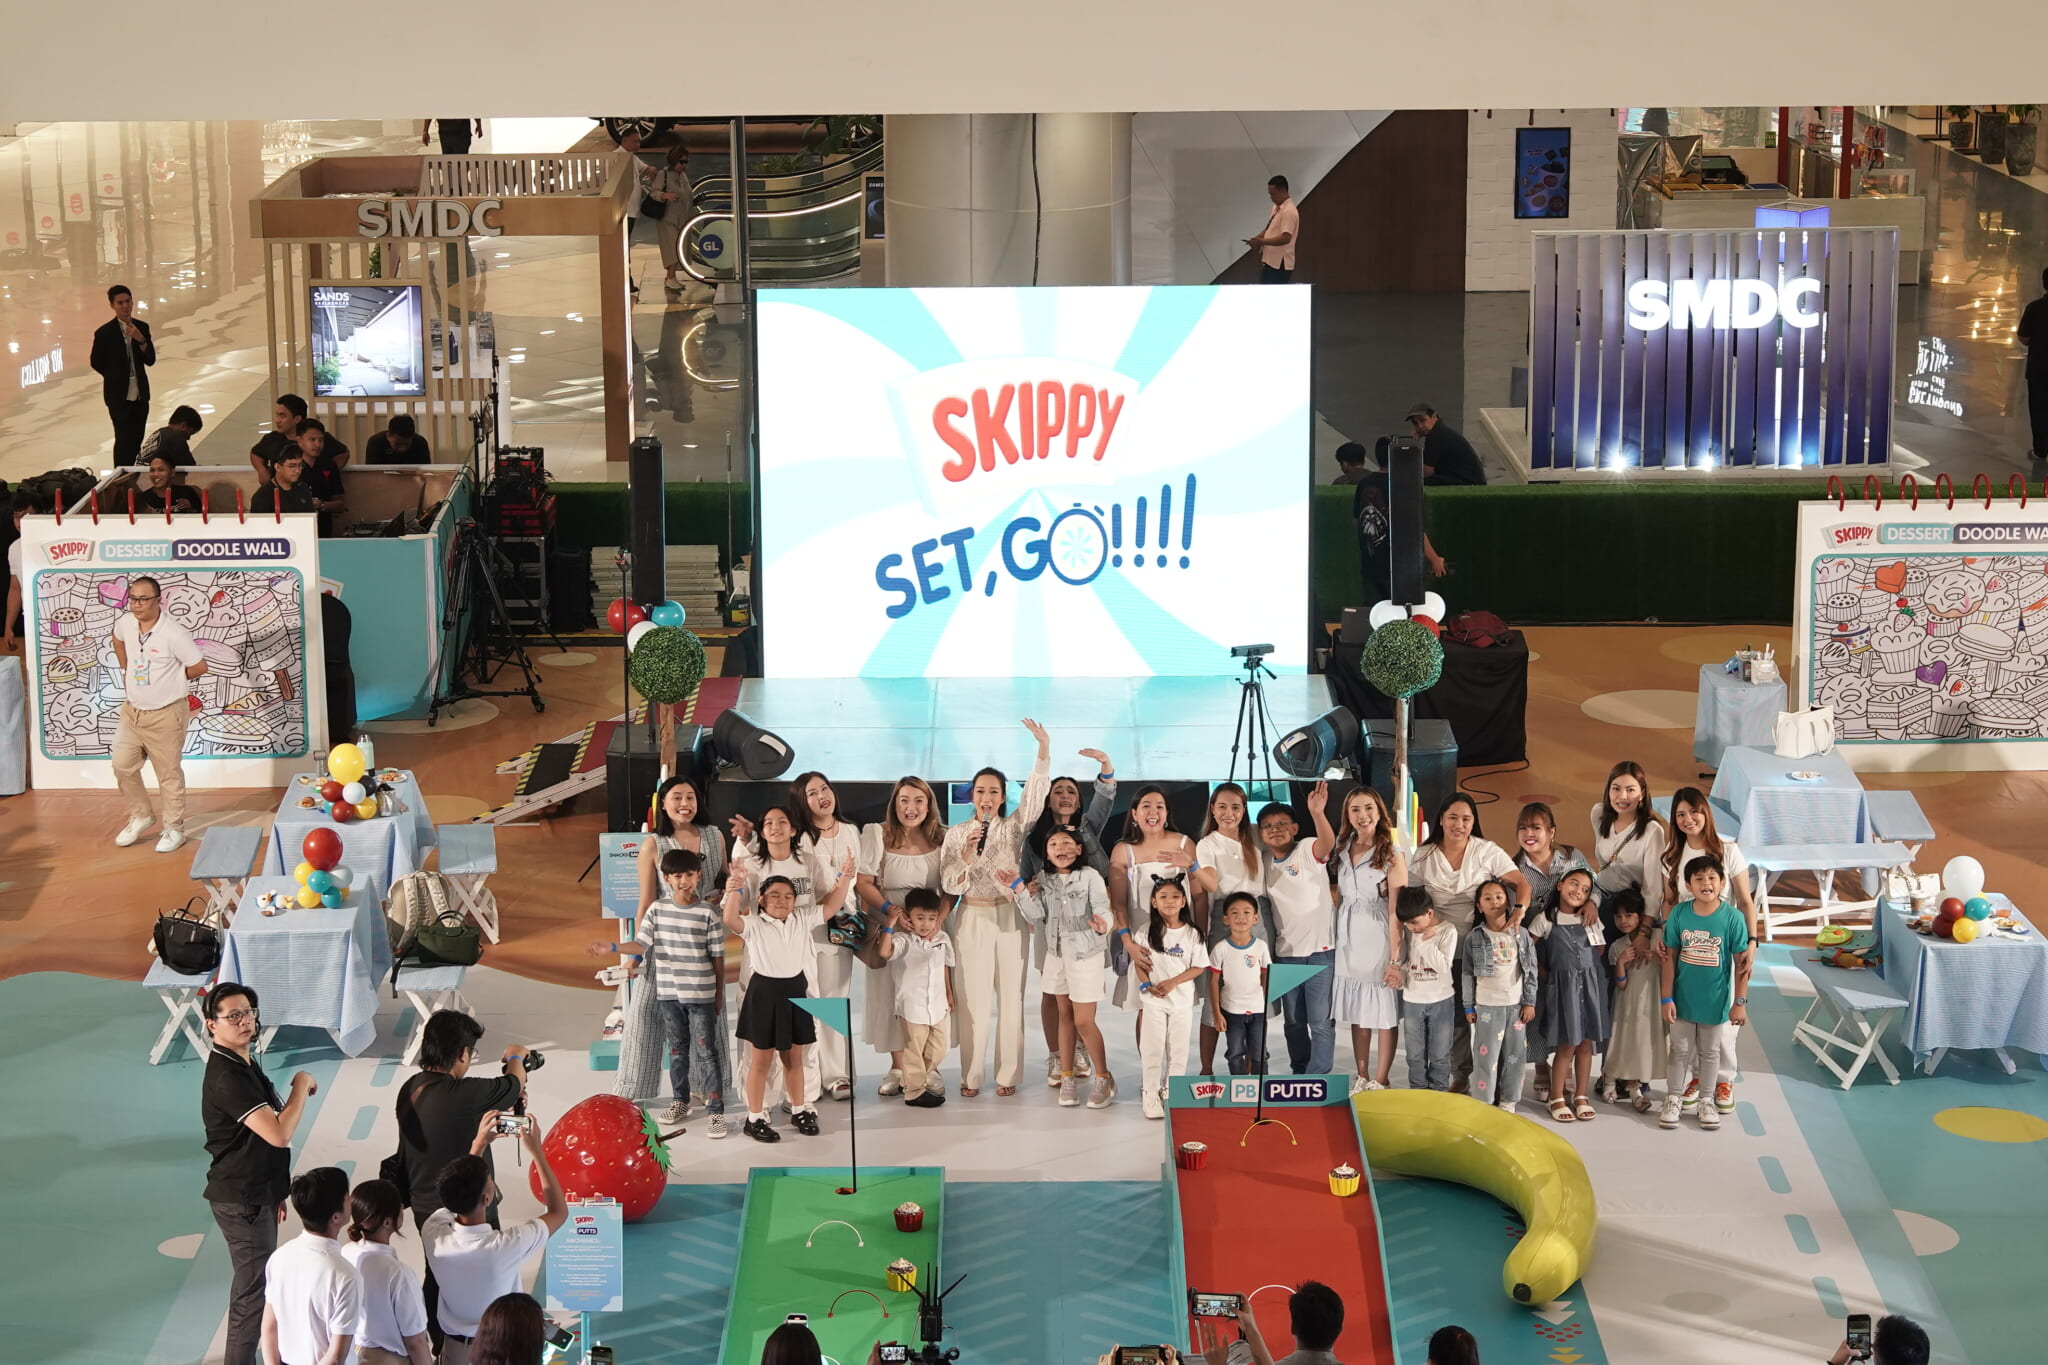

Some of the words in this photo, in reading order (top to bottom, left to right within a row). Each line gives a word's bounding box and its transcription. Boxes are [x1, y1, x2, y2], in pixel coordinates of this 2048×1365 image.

[357, 199, 502, 238] SMDC
[702, 241, 720, 251] GL
[313, 291, 350, 301] SANDS
[1628, 277, 1820, 331] SMDC
[932, 380, 1125, 483] SKIPPY
[1834, 526, 1874, 544] SKIPPY
[1887, 527, 1951, 541] DESSERT
[1959, 527, 2022, 541] DOODLE
[50, 541, 89, 560] SKIPPY
[105, 543, 169, 558] DESSERT
[177, 542, 241, 557] DOODLE
[244, 541, 286, 556] WALL
[1195, 1084, 1224, 1097] SKIPPY
[1235, 1084, 1257, 1098] PB
[1270, 1083, 1323, 1099] PUTTS
